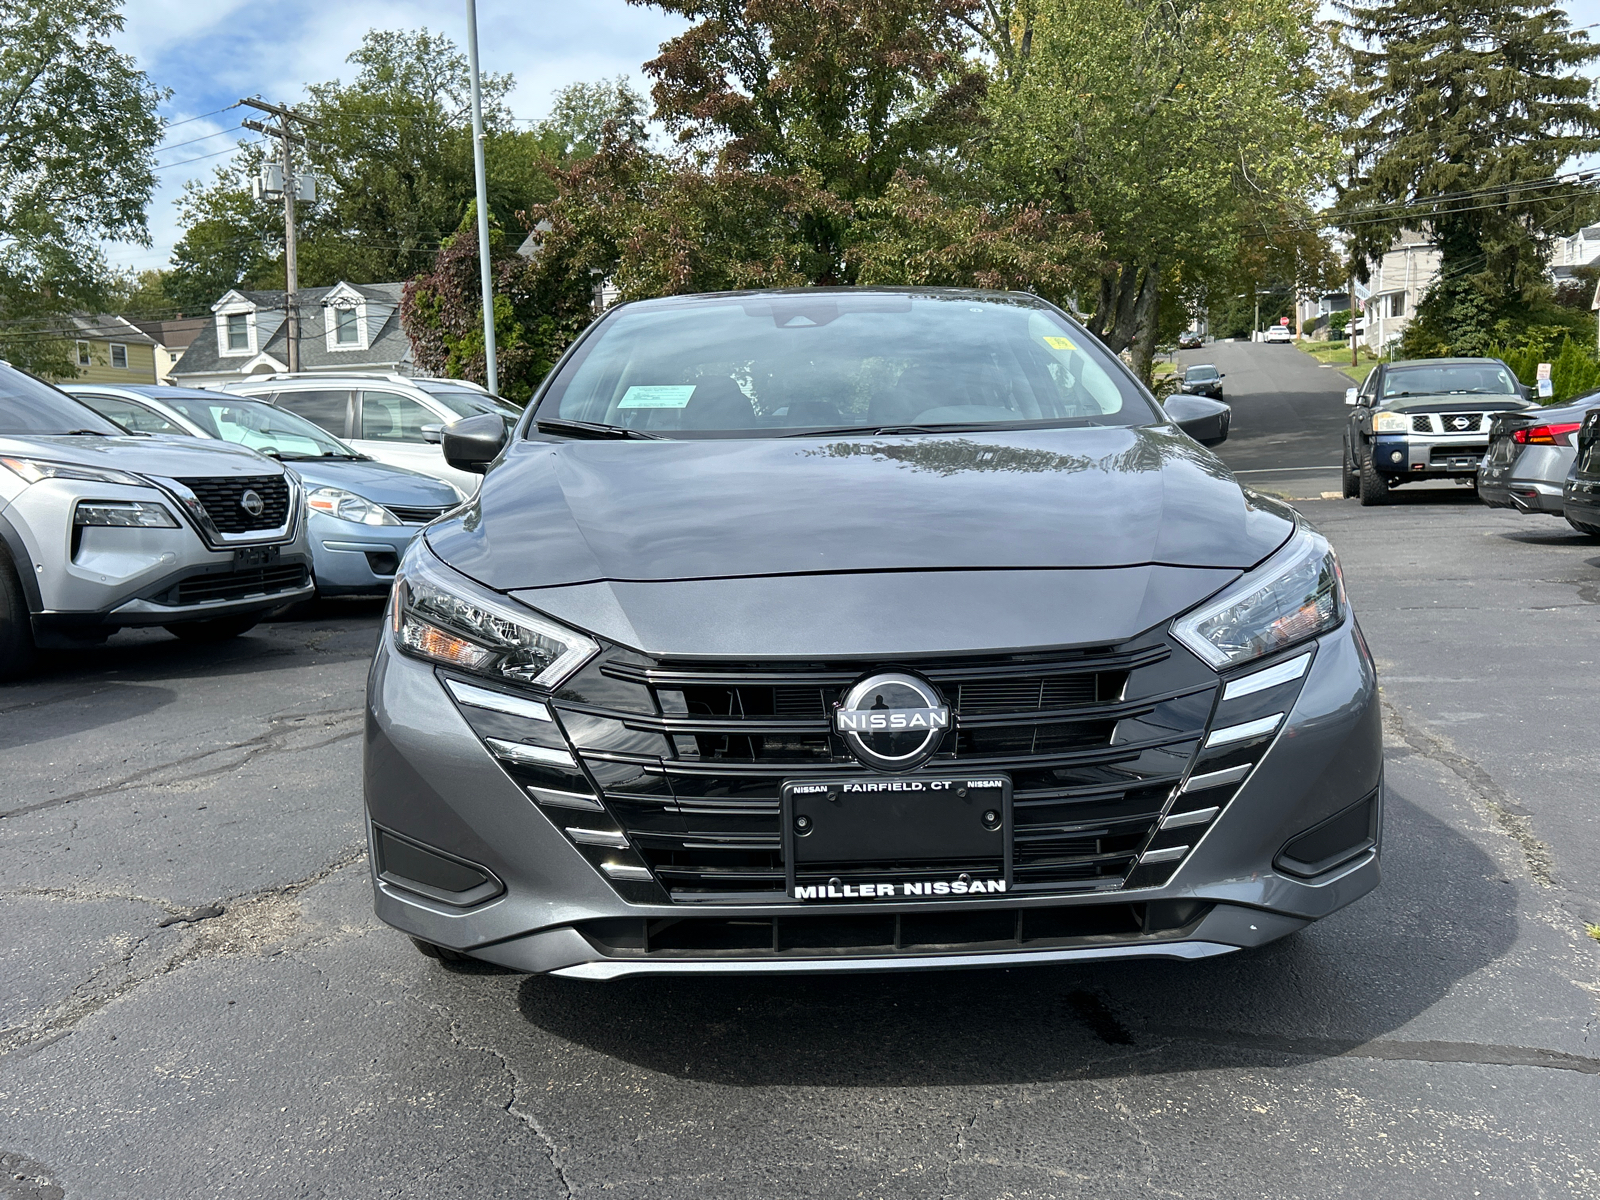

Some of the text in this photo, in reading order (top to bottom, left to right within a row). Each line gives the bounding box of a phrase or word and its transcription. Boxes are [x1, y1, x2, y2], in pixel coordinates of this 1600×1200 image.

[840, 711, 946, 729] NISSAN
[793, 785, 828, 794] NISSAN
[843, 781, 952, 792] FAIRFIELD, CT
[967, 780, 1002, 788] NISSAN
[794, 879, 1006, 899] MILLER NISSAN
